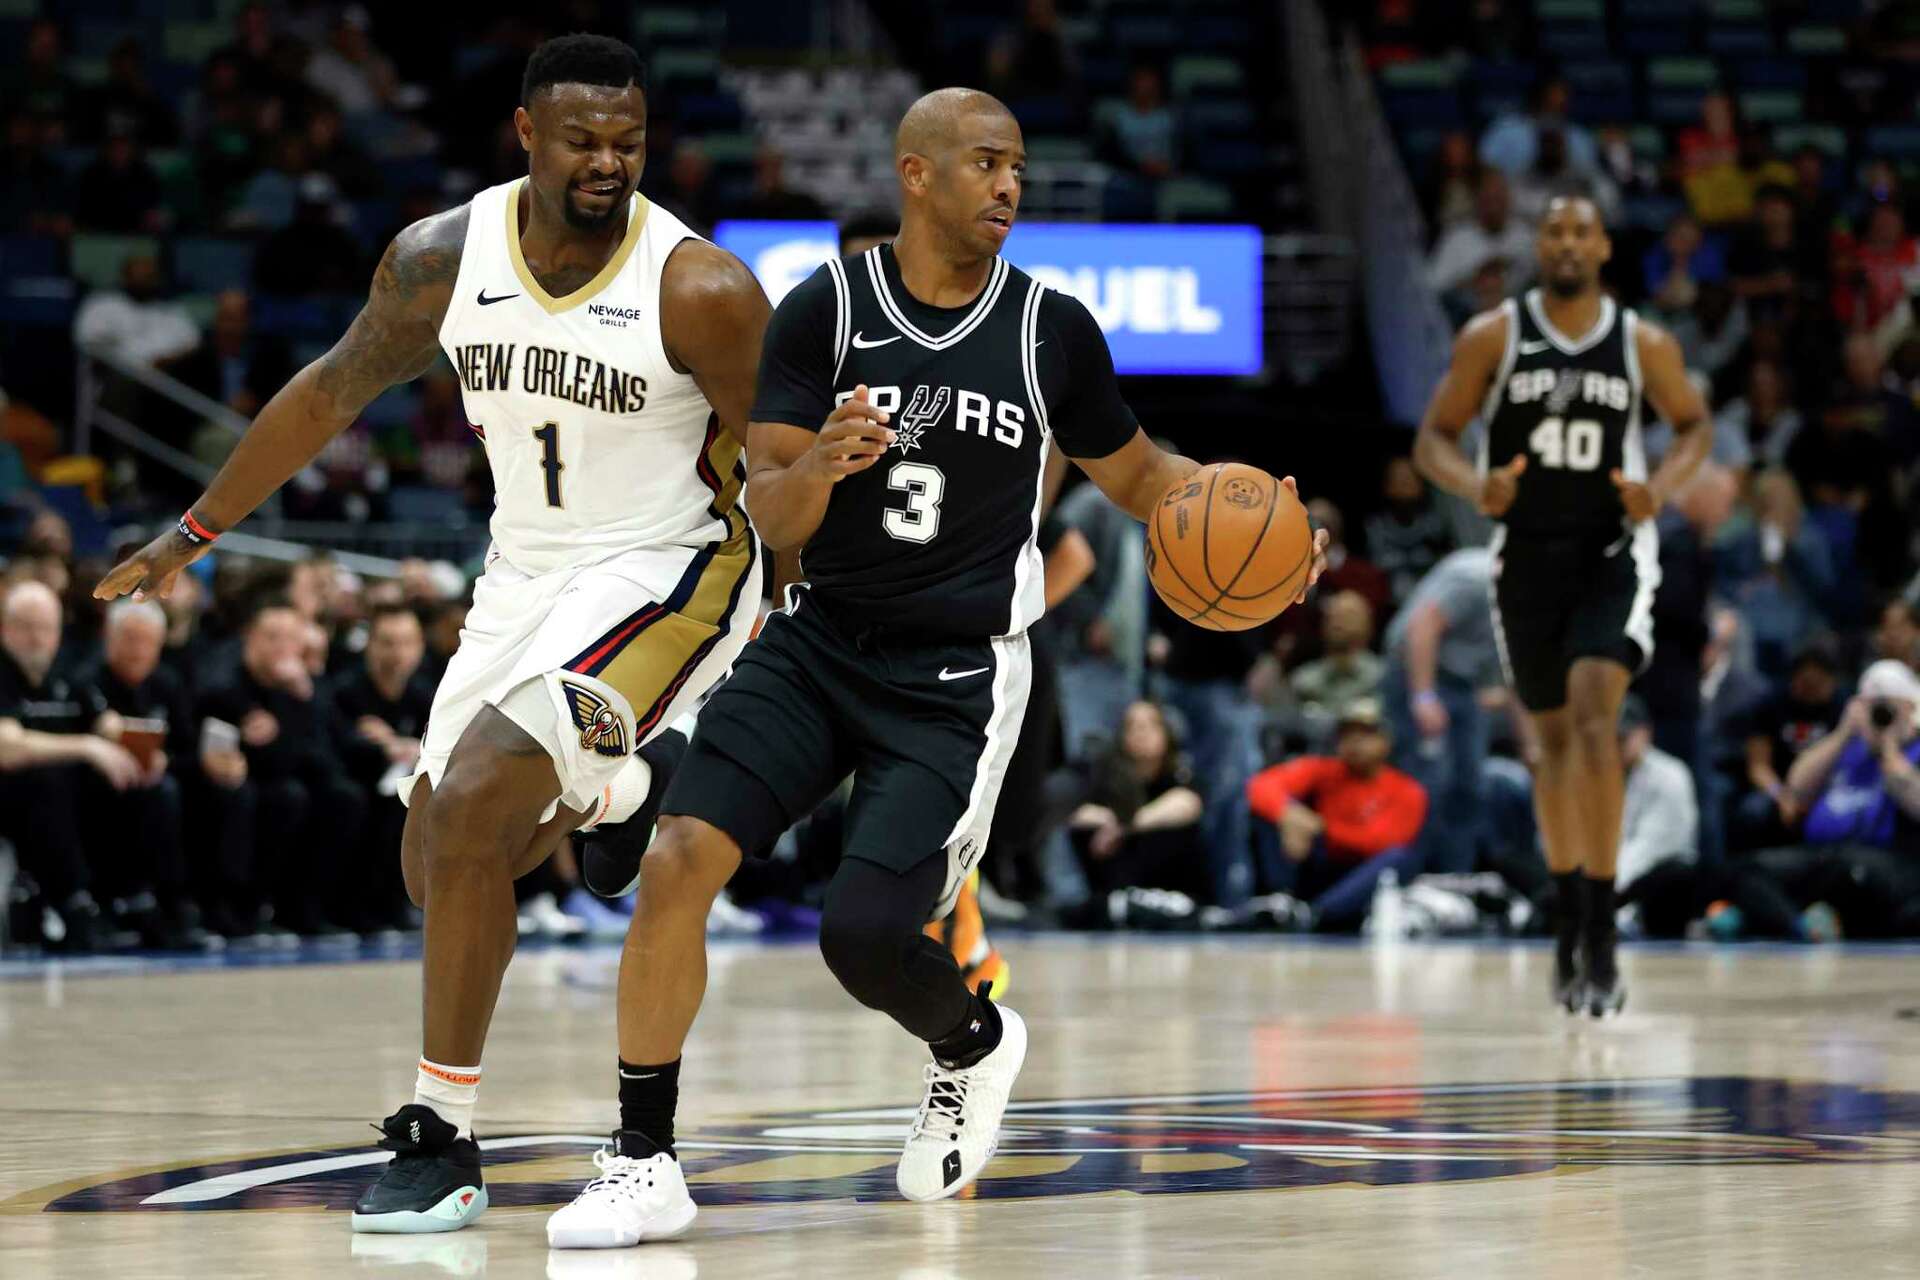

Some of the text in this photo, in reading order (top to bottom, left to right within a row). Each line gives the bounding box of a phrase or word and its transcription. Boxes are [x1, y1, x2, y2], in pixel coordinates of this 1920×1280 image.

[588, 304, 641, 321] NEWAGE
[599, 318, 627, 328] GRILLS
[455, 343, 648, 414] NEW ORLEANS
[532, 421, 565, 509] 1
[1529, 416, 1603, 471] 40
[882, 461, 946, 545] 3
